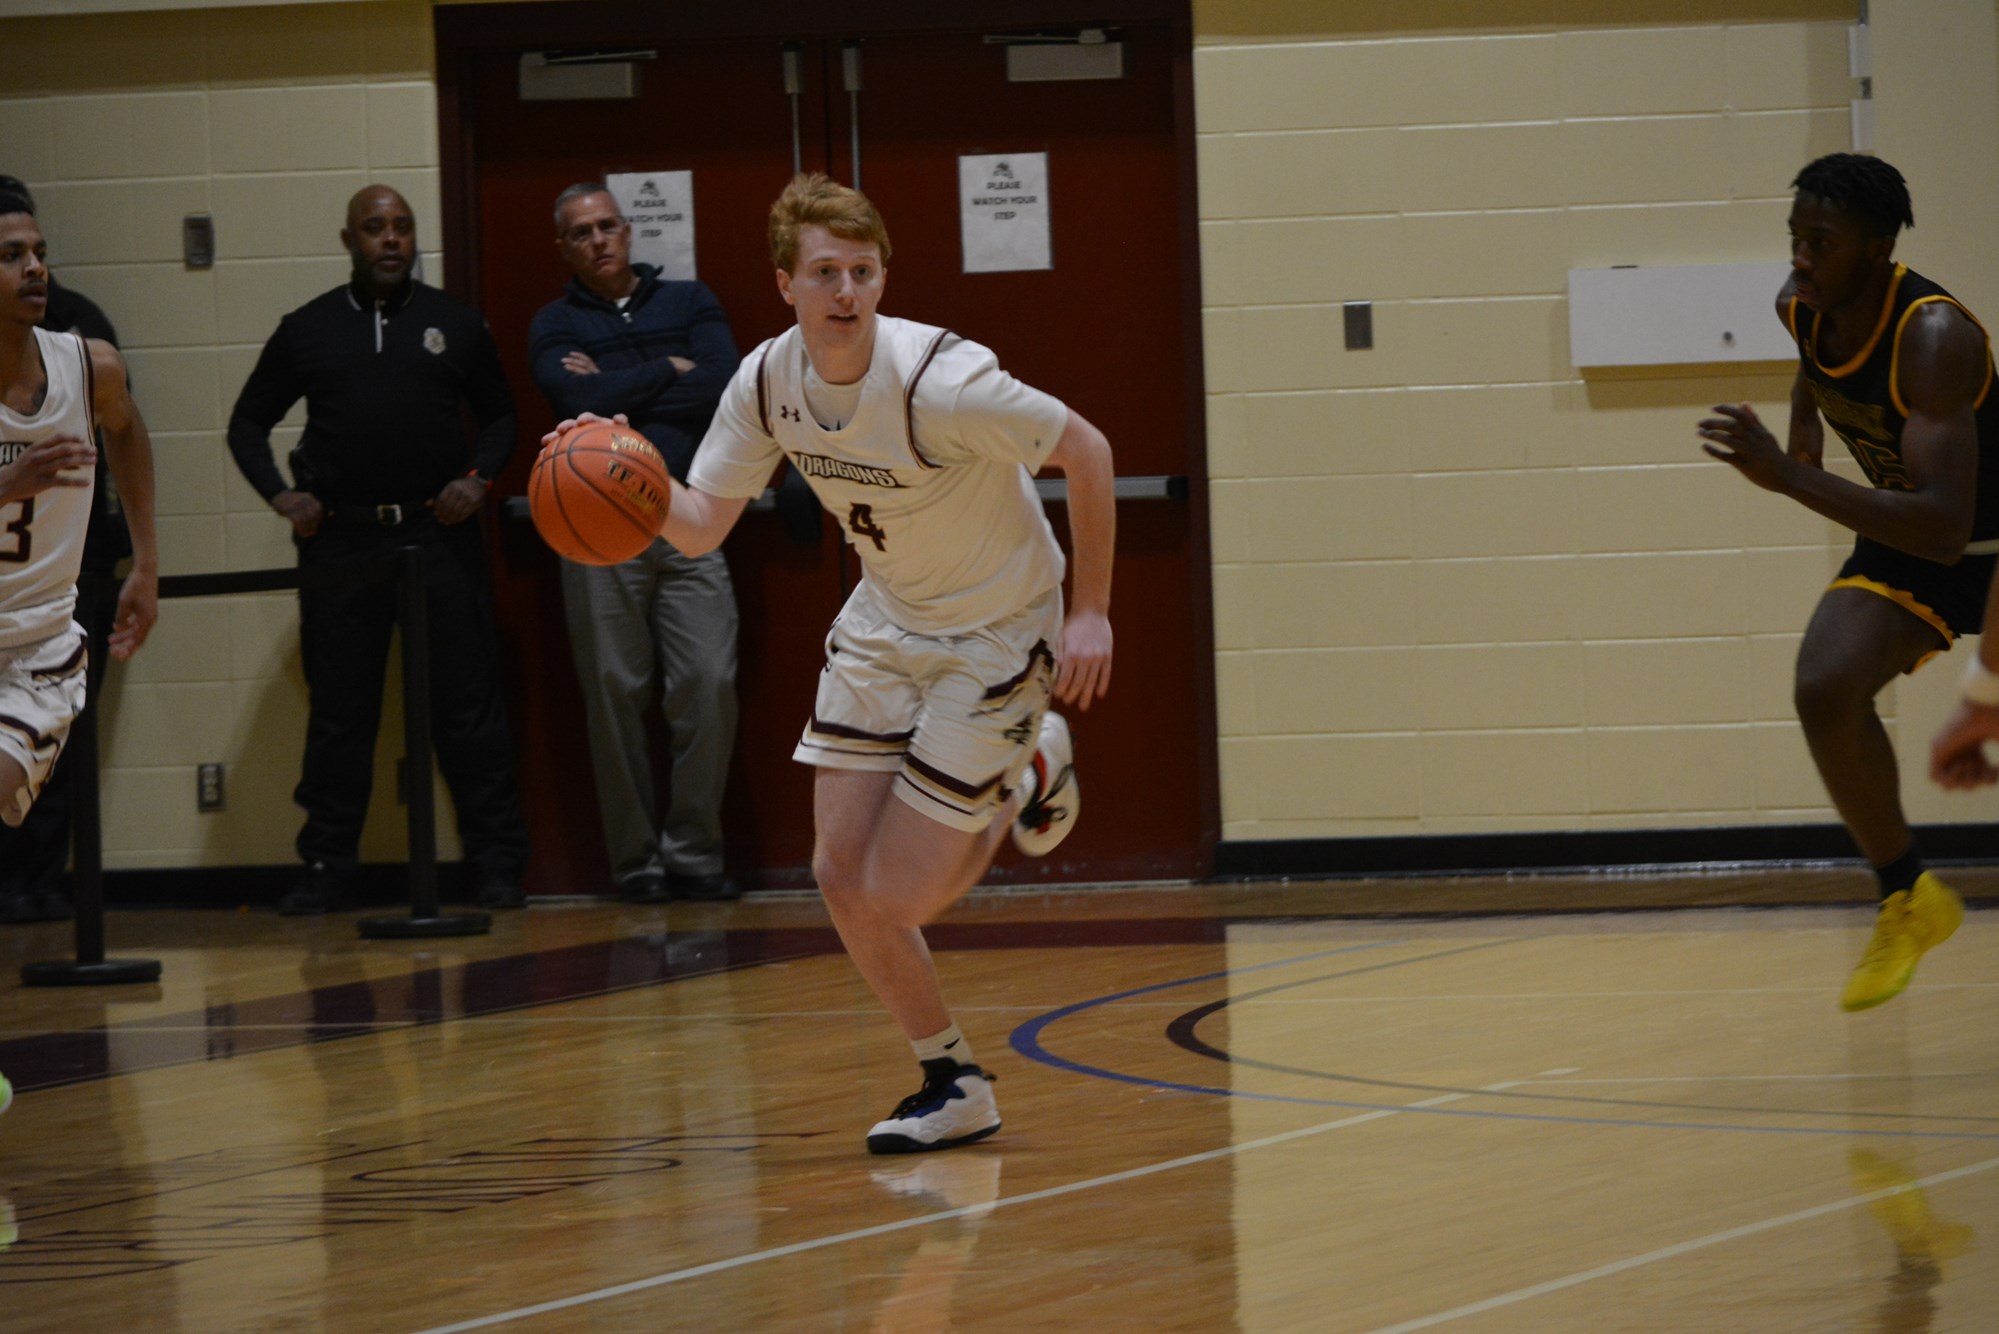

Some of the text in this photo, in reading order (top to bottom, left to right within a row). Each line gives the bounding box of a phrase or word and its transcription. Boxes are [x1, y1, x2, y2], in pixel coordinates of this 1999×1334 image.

[985, 181, 1021, 190] PLEASE
[972, 195, 1038, 206] WATCH YOUR
[624, 215, 654, 223] ATCH
[798, 453, 902, 488] DRAGONS
[848, 501, 888, 553] 4
